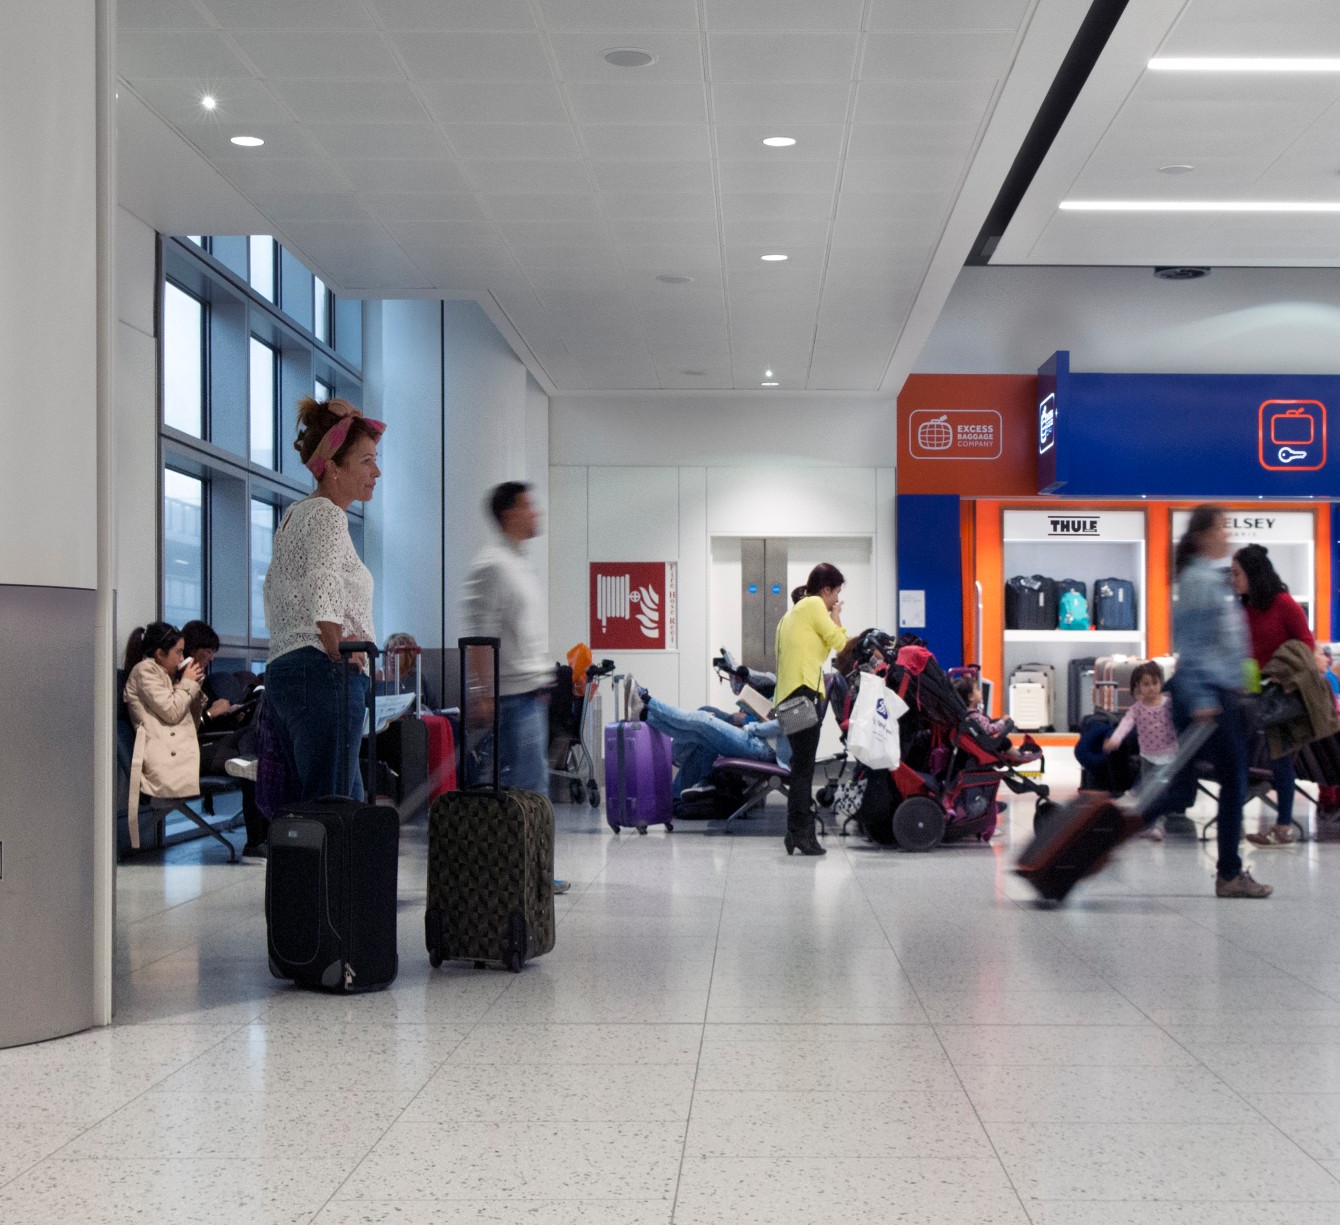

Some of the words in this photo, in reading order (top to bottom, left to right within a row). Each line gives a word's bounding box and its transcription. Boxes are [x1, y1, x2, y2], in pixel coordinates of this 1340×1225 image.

[957, 425, 994, 433] EXCESS
[1050, 520, 1098, 533] THULE
[1224, 518, 1276, 529] ELSEY
